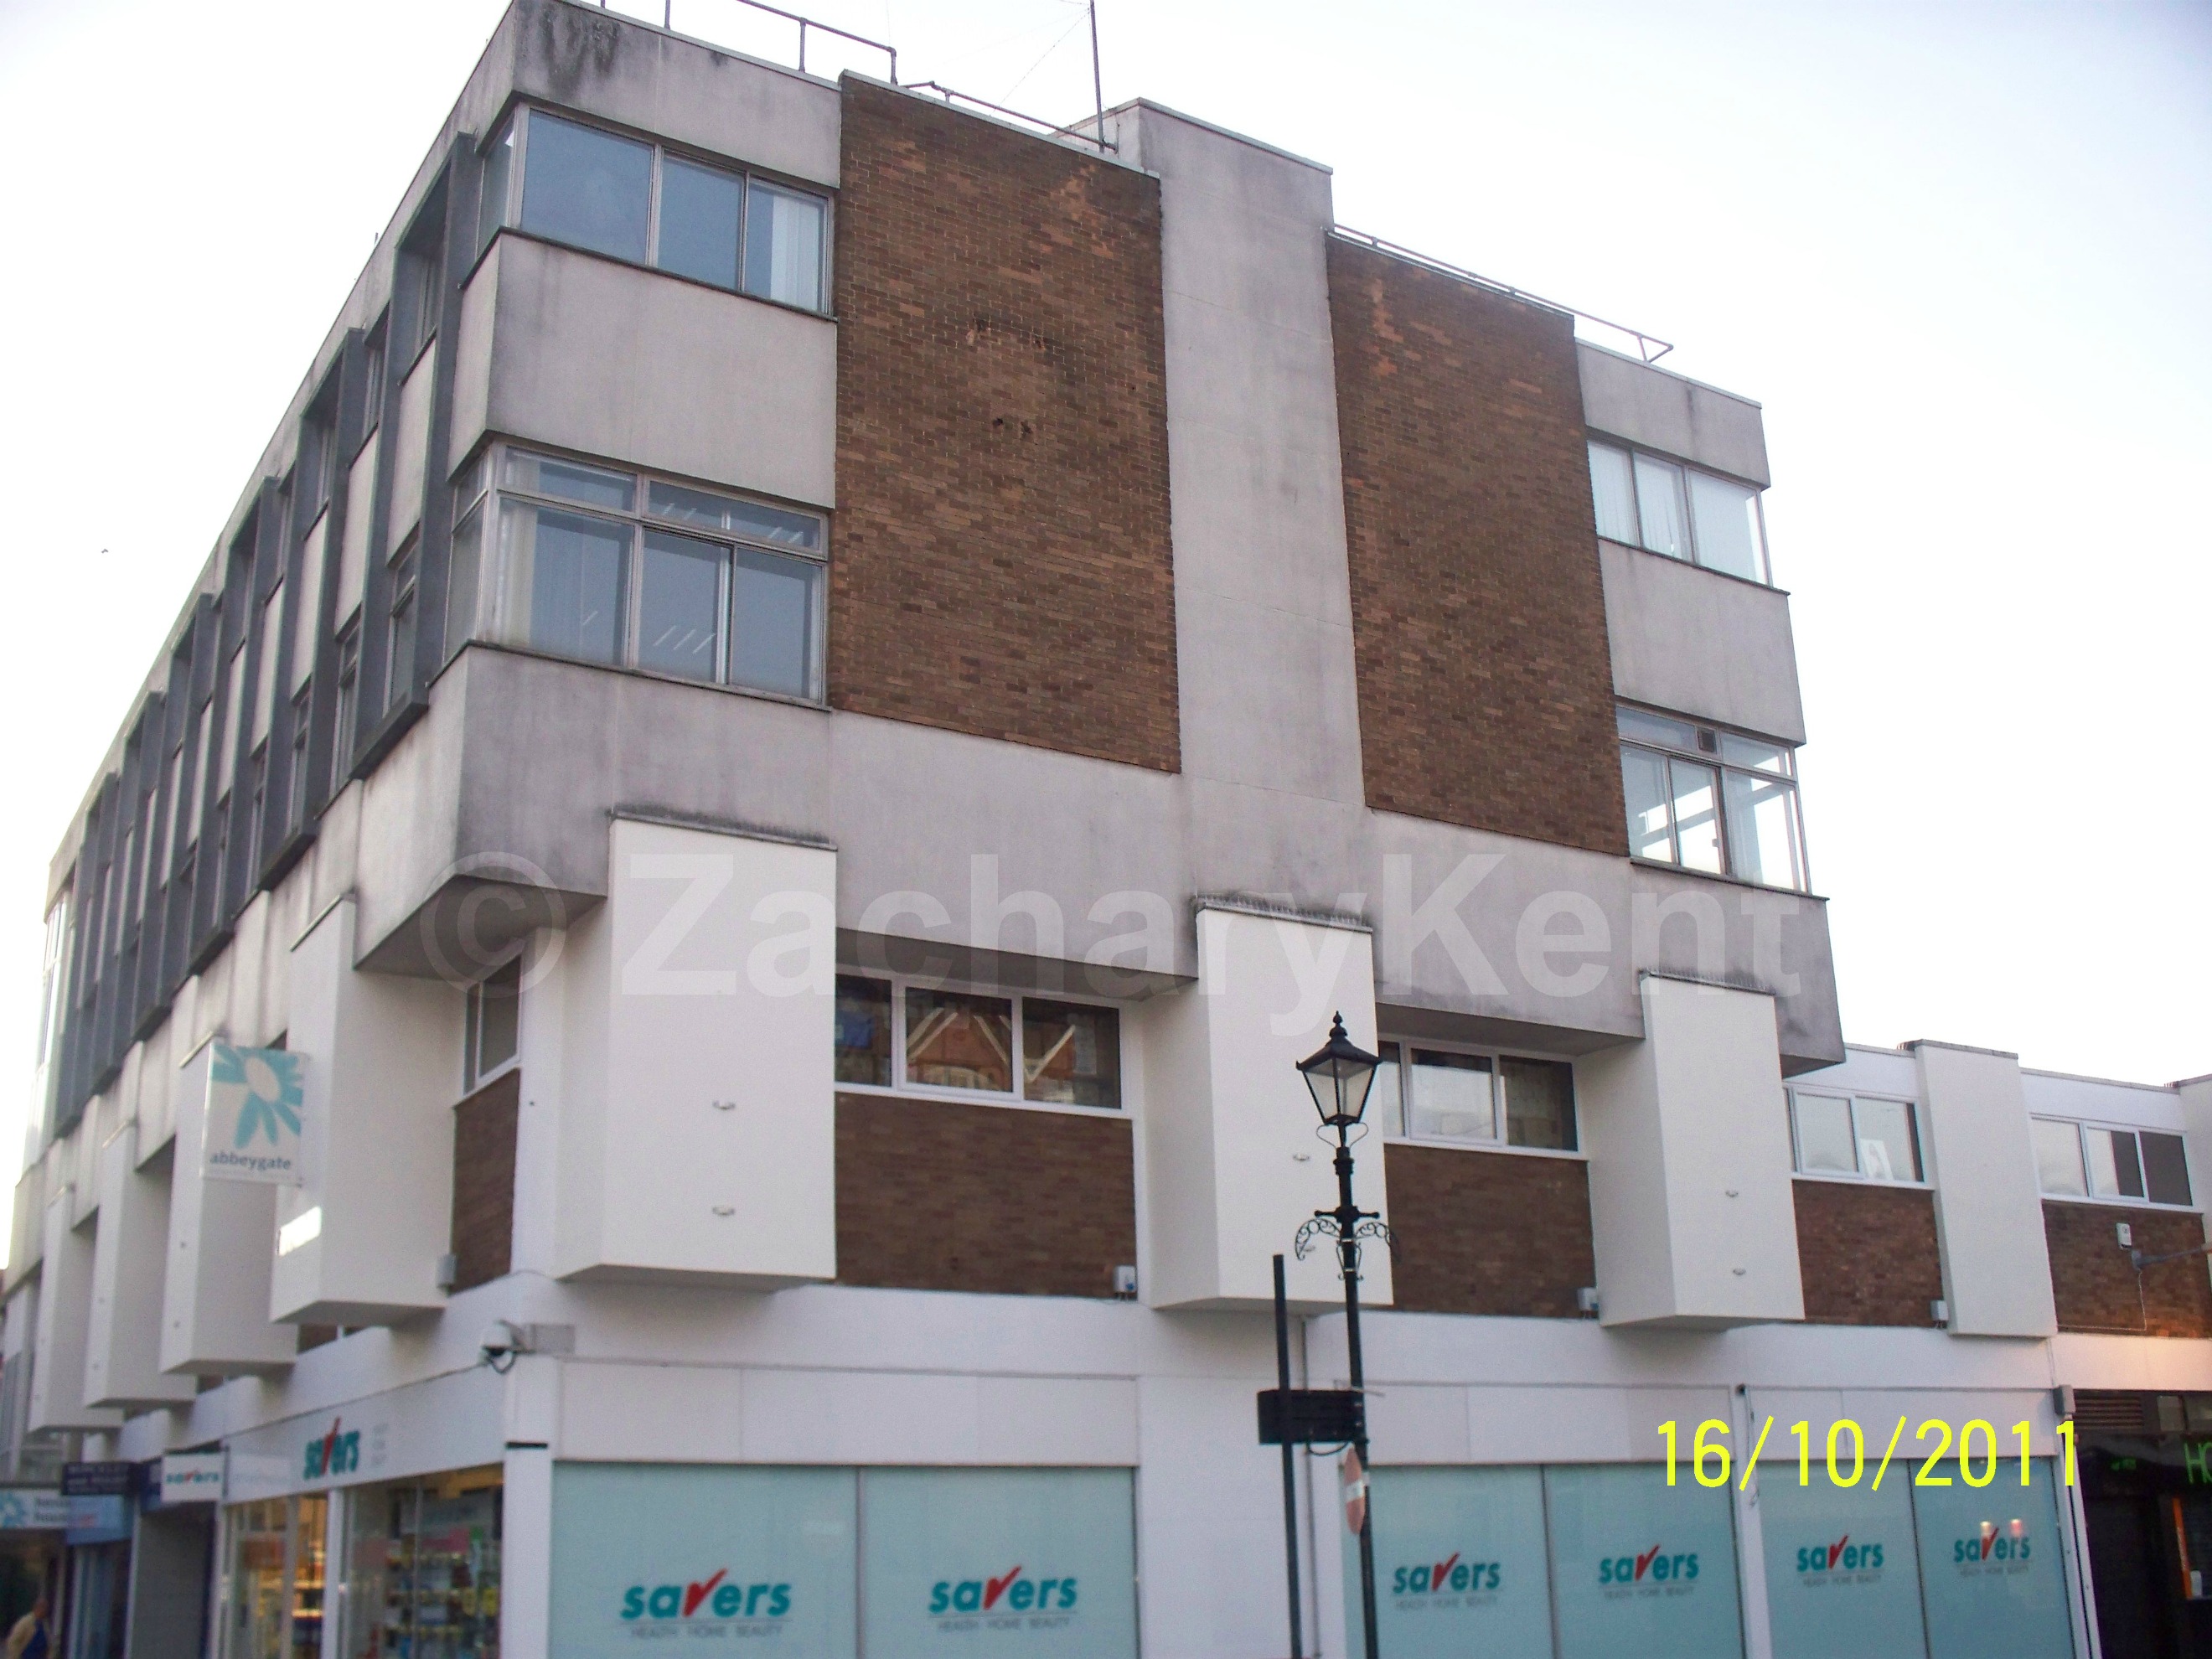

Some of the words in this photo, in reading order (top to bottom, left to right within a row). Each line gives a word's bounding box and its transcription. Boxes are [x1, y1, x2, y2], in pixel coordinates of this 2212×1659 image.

[210, 1151, 291, 1171] abbeygate
[1598, 1544, 1699, 1584] savers
[1796, 1534, 1884, 1572] savers
[1954, 1527, 2030, 1563] savers
[928, 1565, 1078, 1614] savers
[1393, 1552, 1501, 1594] savers
[620, 1568, 792, 1620] savers
